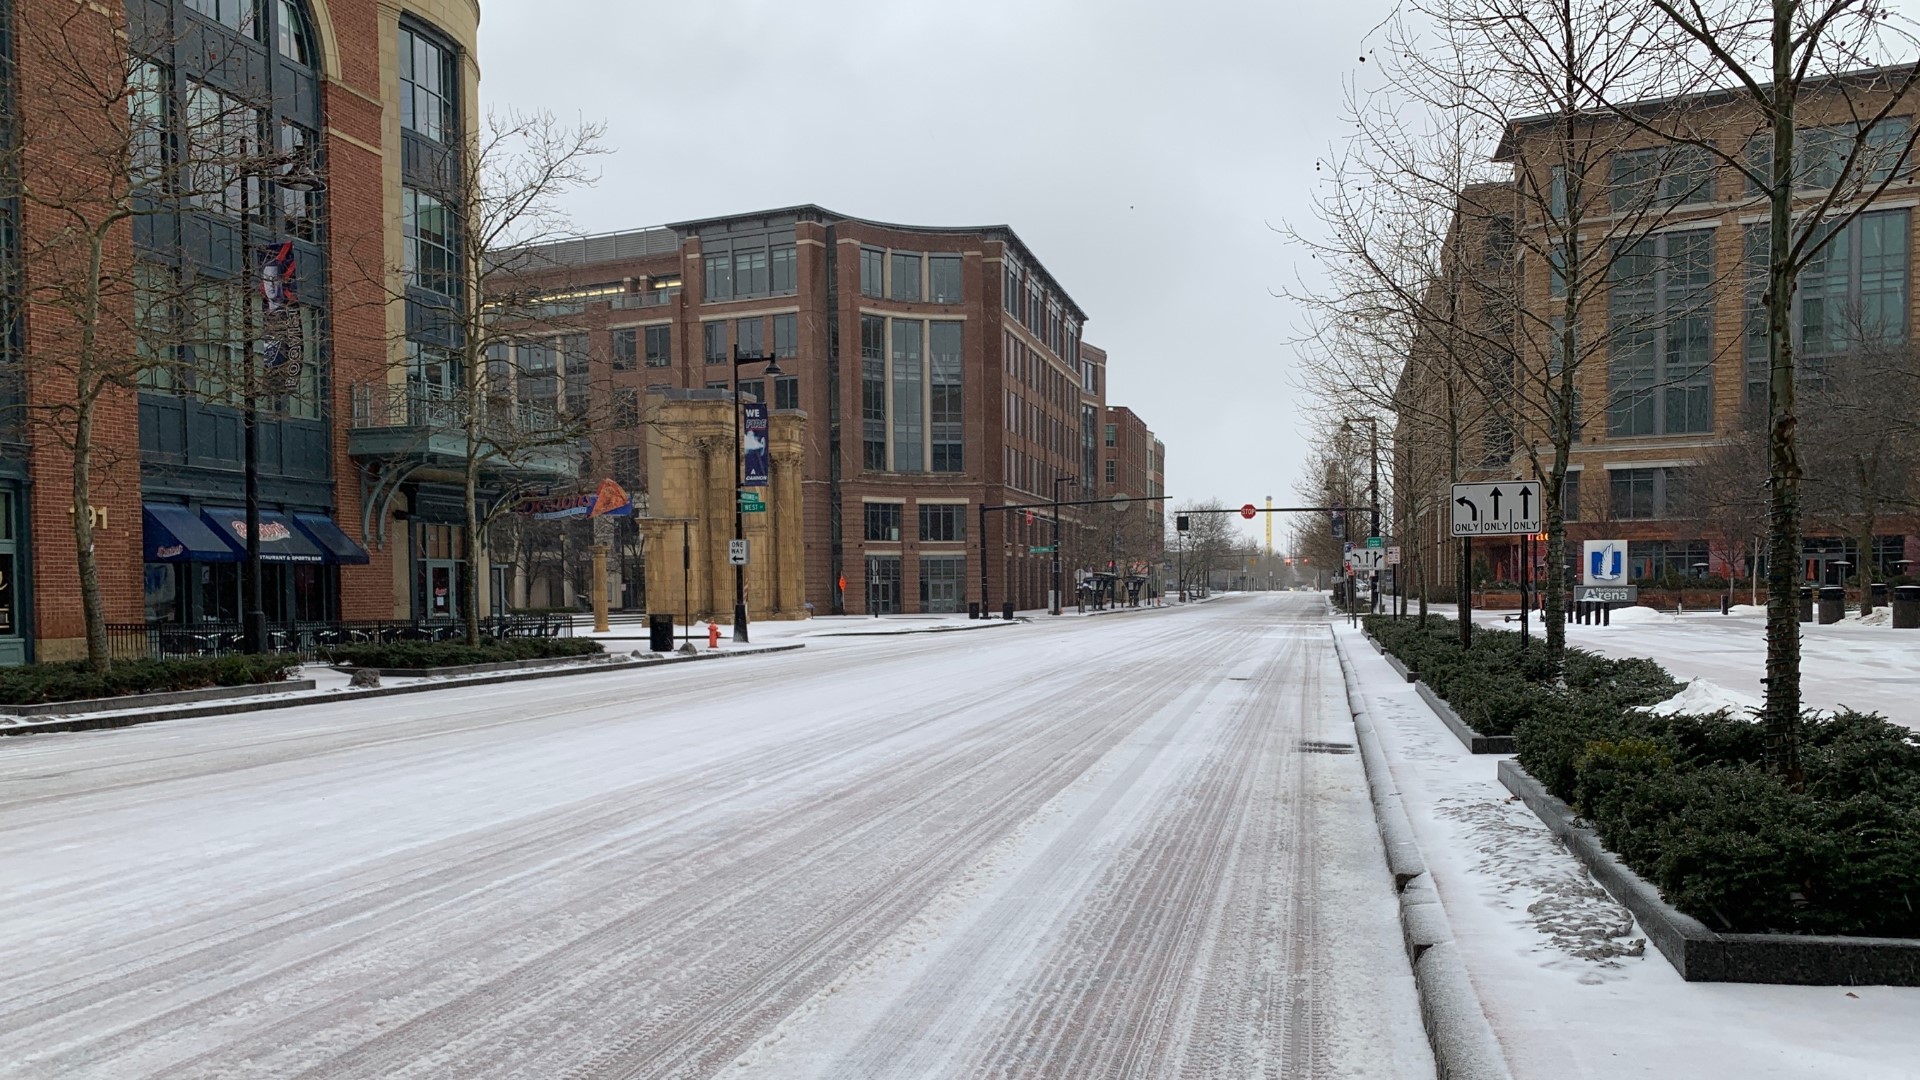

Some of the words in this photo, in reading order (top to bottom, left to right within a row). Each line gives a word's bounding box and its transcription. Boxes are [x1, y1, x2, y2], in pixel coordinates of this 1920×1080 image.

[745, 408, 760, 418] WE
[745, 418, 767, 429] FIRE
[1242, 508, 1256, 516] STOP
[1455, 523, 1479, 532] ONLY
[1484, 522, 1508, 531] ONLY
[1513, 521, 1538, 530] ONLY
[1582, 589, 1628, 601] Arena
